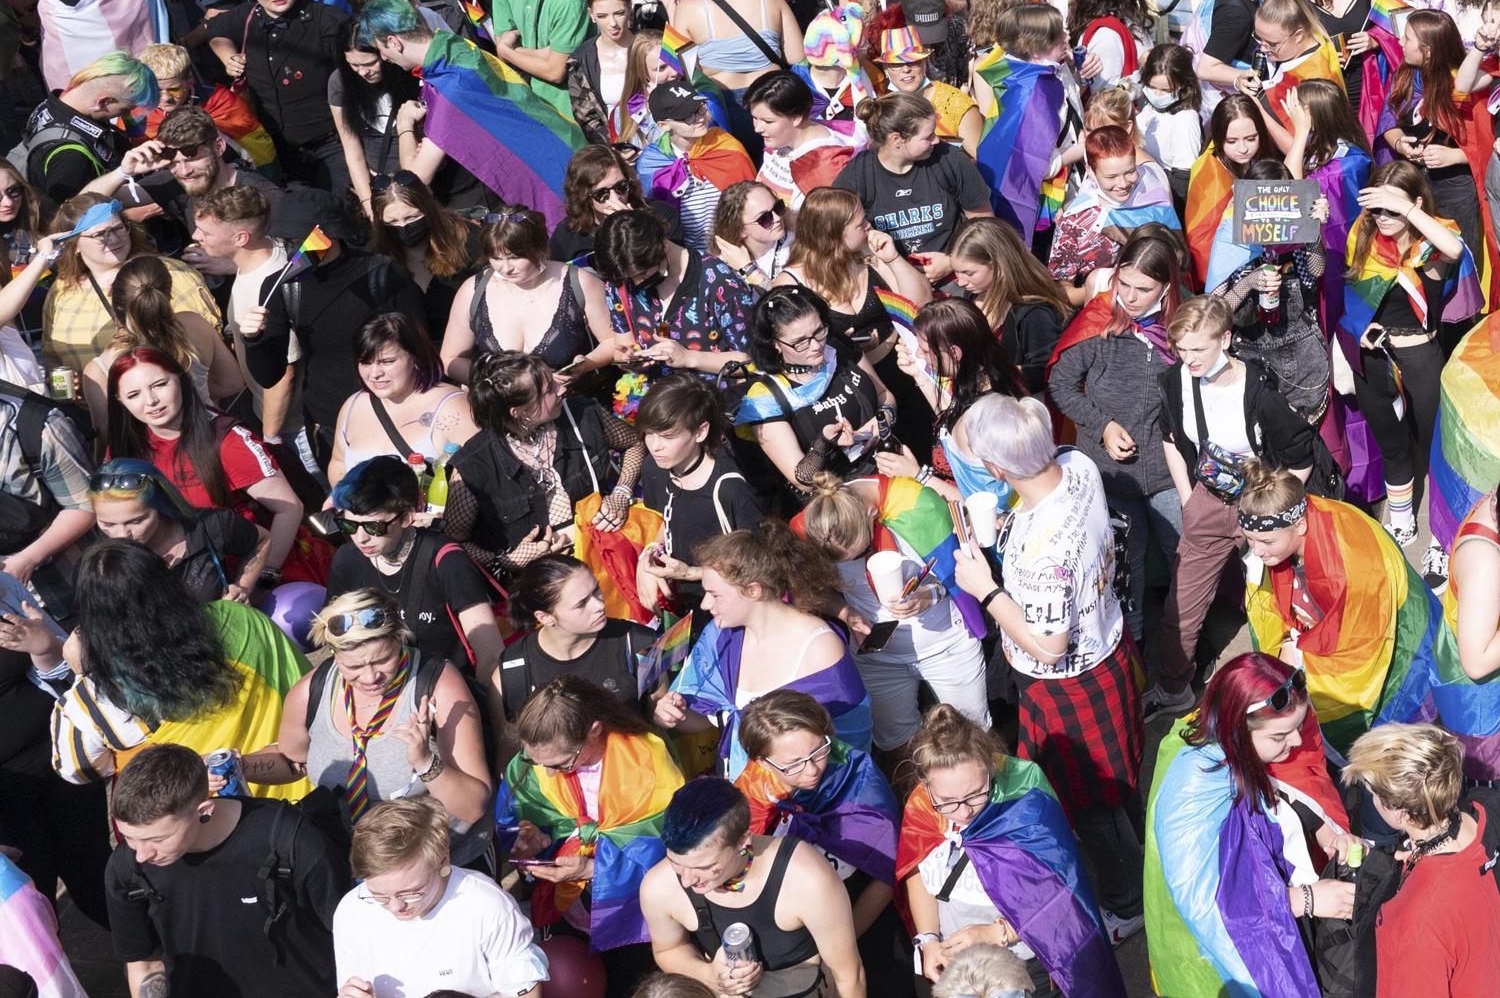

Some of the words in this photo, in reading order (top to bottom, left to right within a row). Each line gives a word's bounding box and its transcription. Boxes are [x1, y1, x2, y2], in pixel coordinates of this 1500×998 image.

[1257, 186, 1273, 194] THE
[1274, 186, 1291, 194] ONLY
[1245, 195, 1300, 212] CHOICE
[874, 204, 944, 231] SHARKS
[1241, 223, 1300, 243] MYSELF
